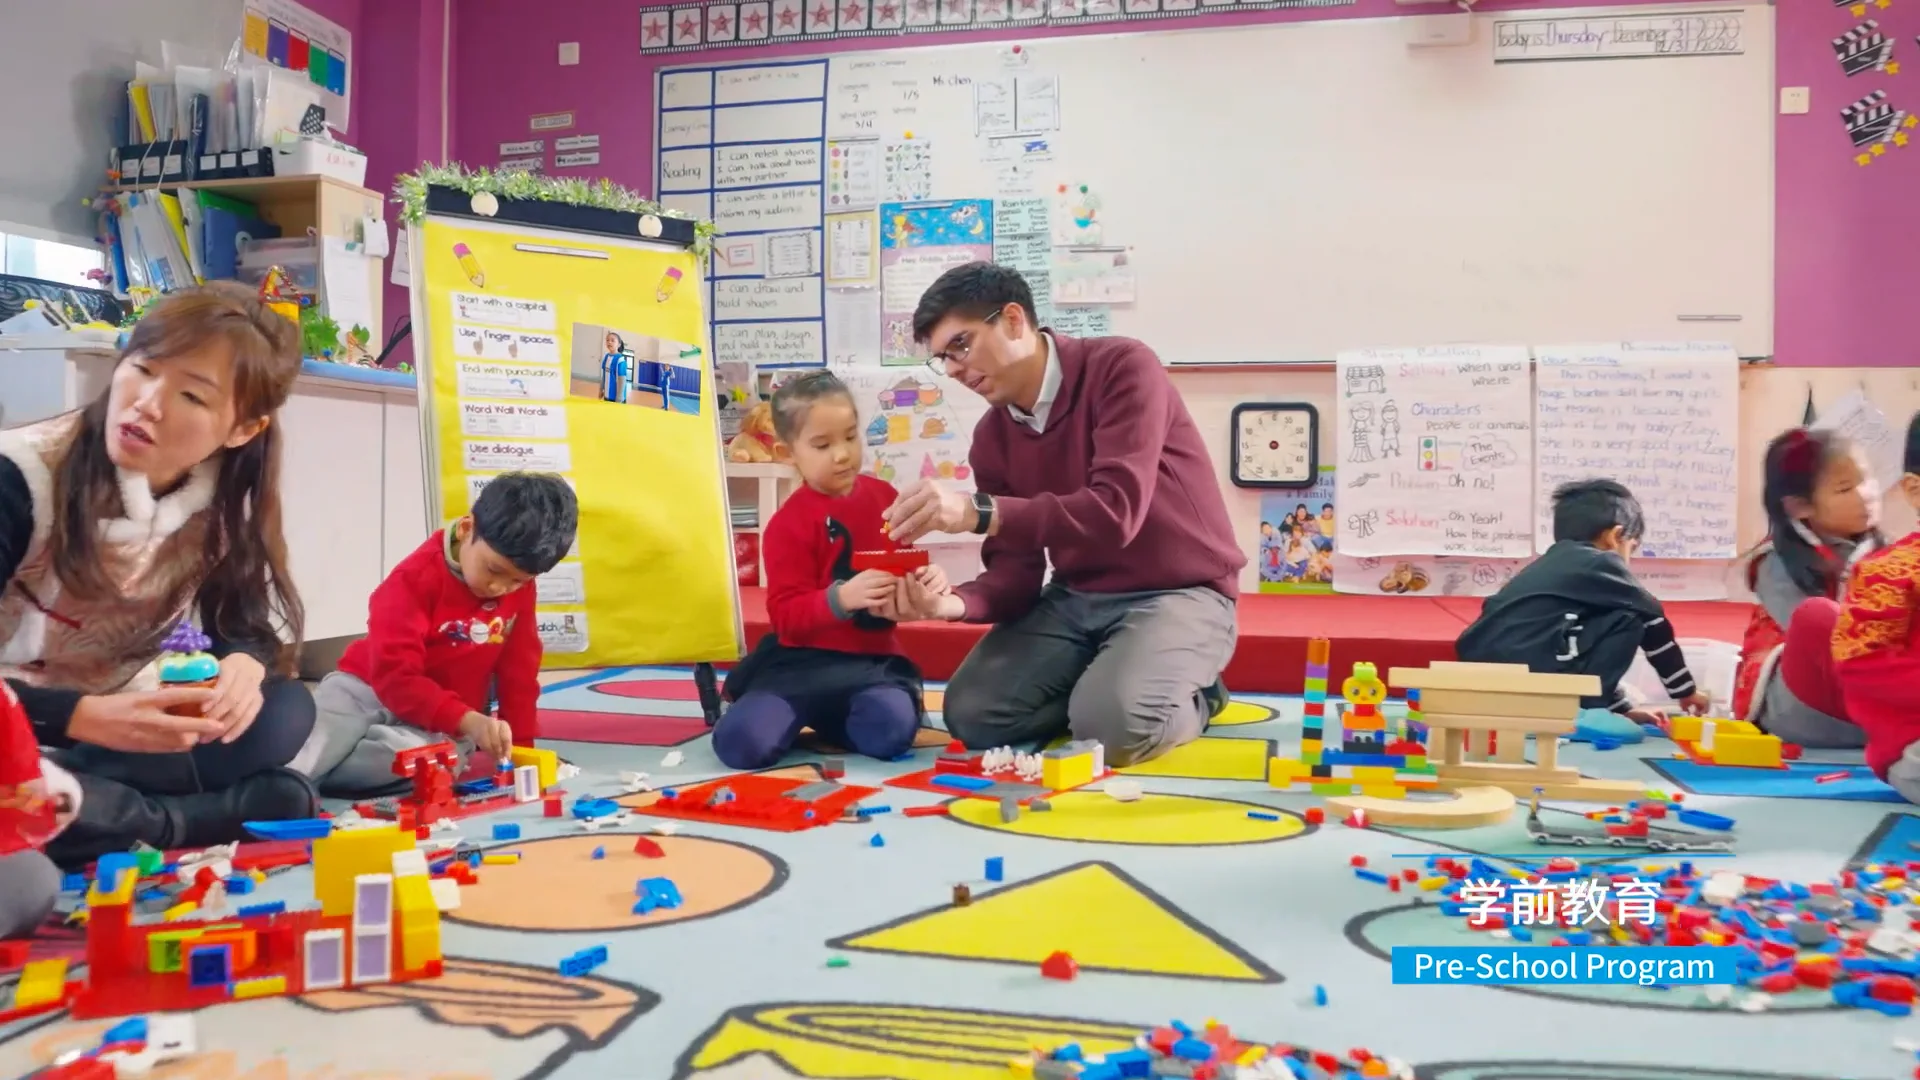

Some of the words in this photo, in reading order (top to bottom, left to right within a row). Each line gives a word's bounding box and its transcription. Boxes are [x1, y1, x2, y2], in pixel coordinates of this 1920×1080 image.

[1547, 21, 1608, 51] Thursday
[730, 152, 749, 161] can
[662, 161, 702, 180] Reading
[728, 164, 745, 173] can
[729, 282, 750, 293] can
[754, 281, 781, 294] draw
[785, 281, 804, 294] and
[456, 293, 479, 304] Start
[483, 297, 503, 307] with
[505, 300, 513, 308] a
[716, 296, 741, 308] build
[458, 328, 477, 338] Use
[484, 329, 512, 343] finger
[462, 363, 481, 374] End
[484, 366, 504, 376] with
[1498, 361, 1522, 373] and
[465, 404, 492, 415] Word
[495, 405, 514, 415] Wall
[518, 406, 549, 417] Words
[1411, 401, 1483, 417] Characters
[469, 443, 489, 454] Use
[491, 444, 534, 457] dialogue
[1297, 488, 1334, 502] Family
[537, 621, 557, 632] atch
